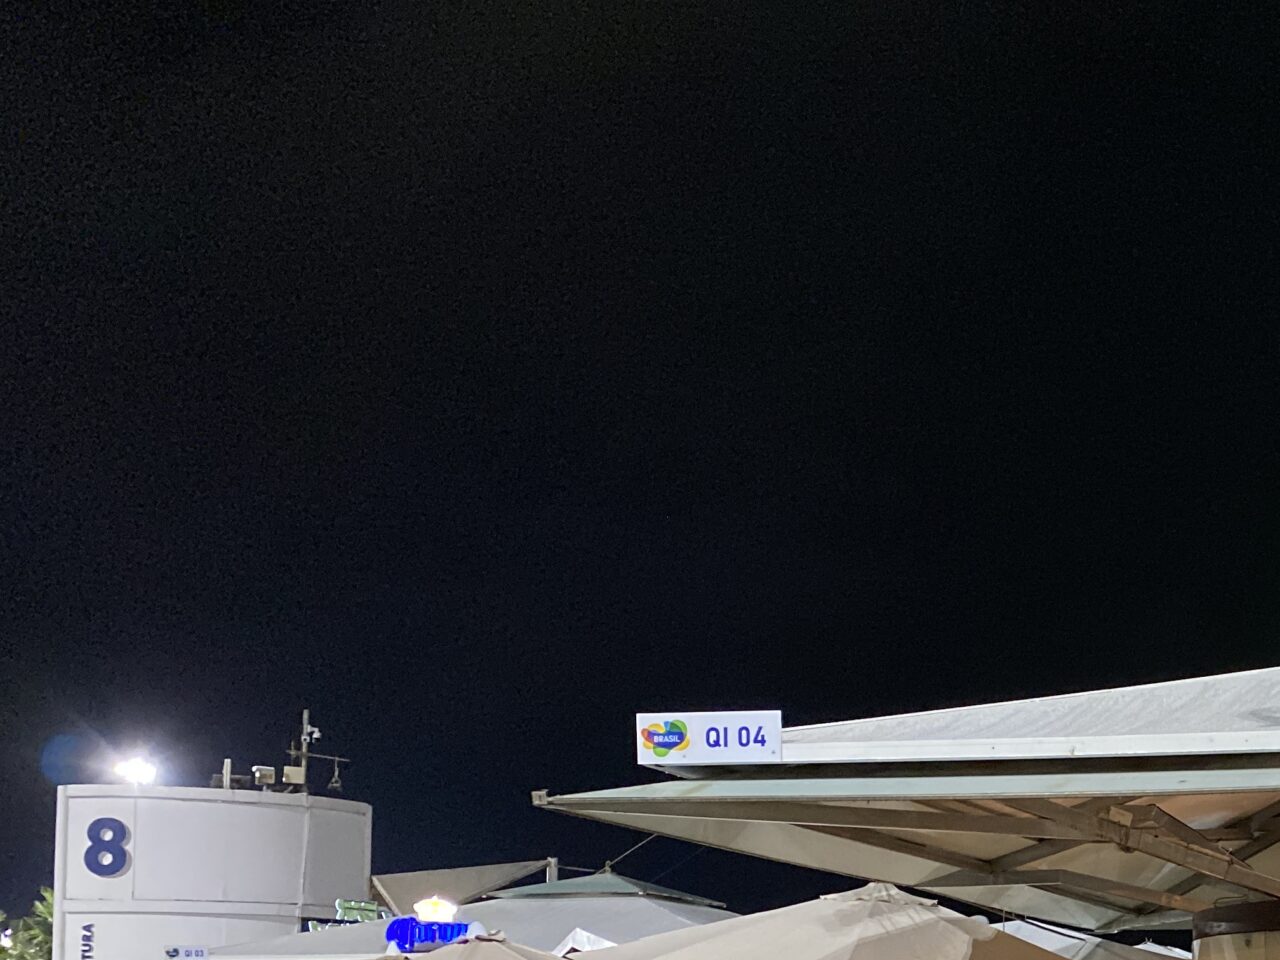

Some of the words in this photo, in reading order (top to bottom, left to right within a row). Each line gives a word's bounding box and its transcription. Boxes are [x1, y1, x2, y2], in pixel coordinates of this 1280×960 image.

[653, 735, 681, 743] BRASIL
[705, 727, 728, 748] QI
[737, 726, 767, 747] 04
[84, 817, 128, 877] 8
